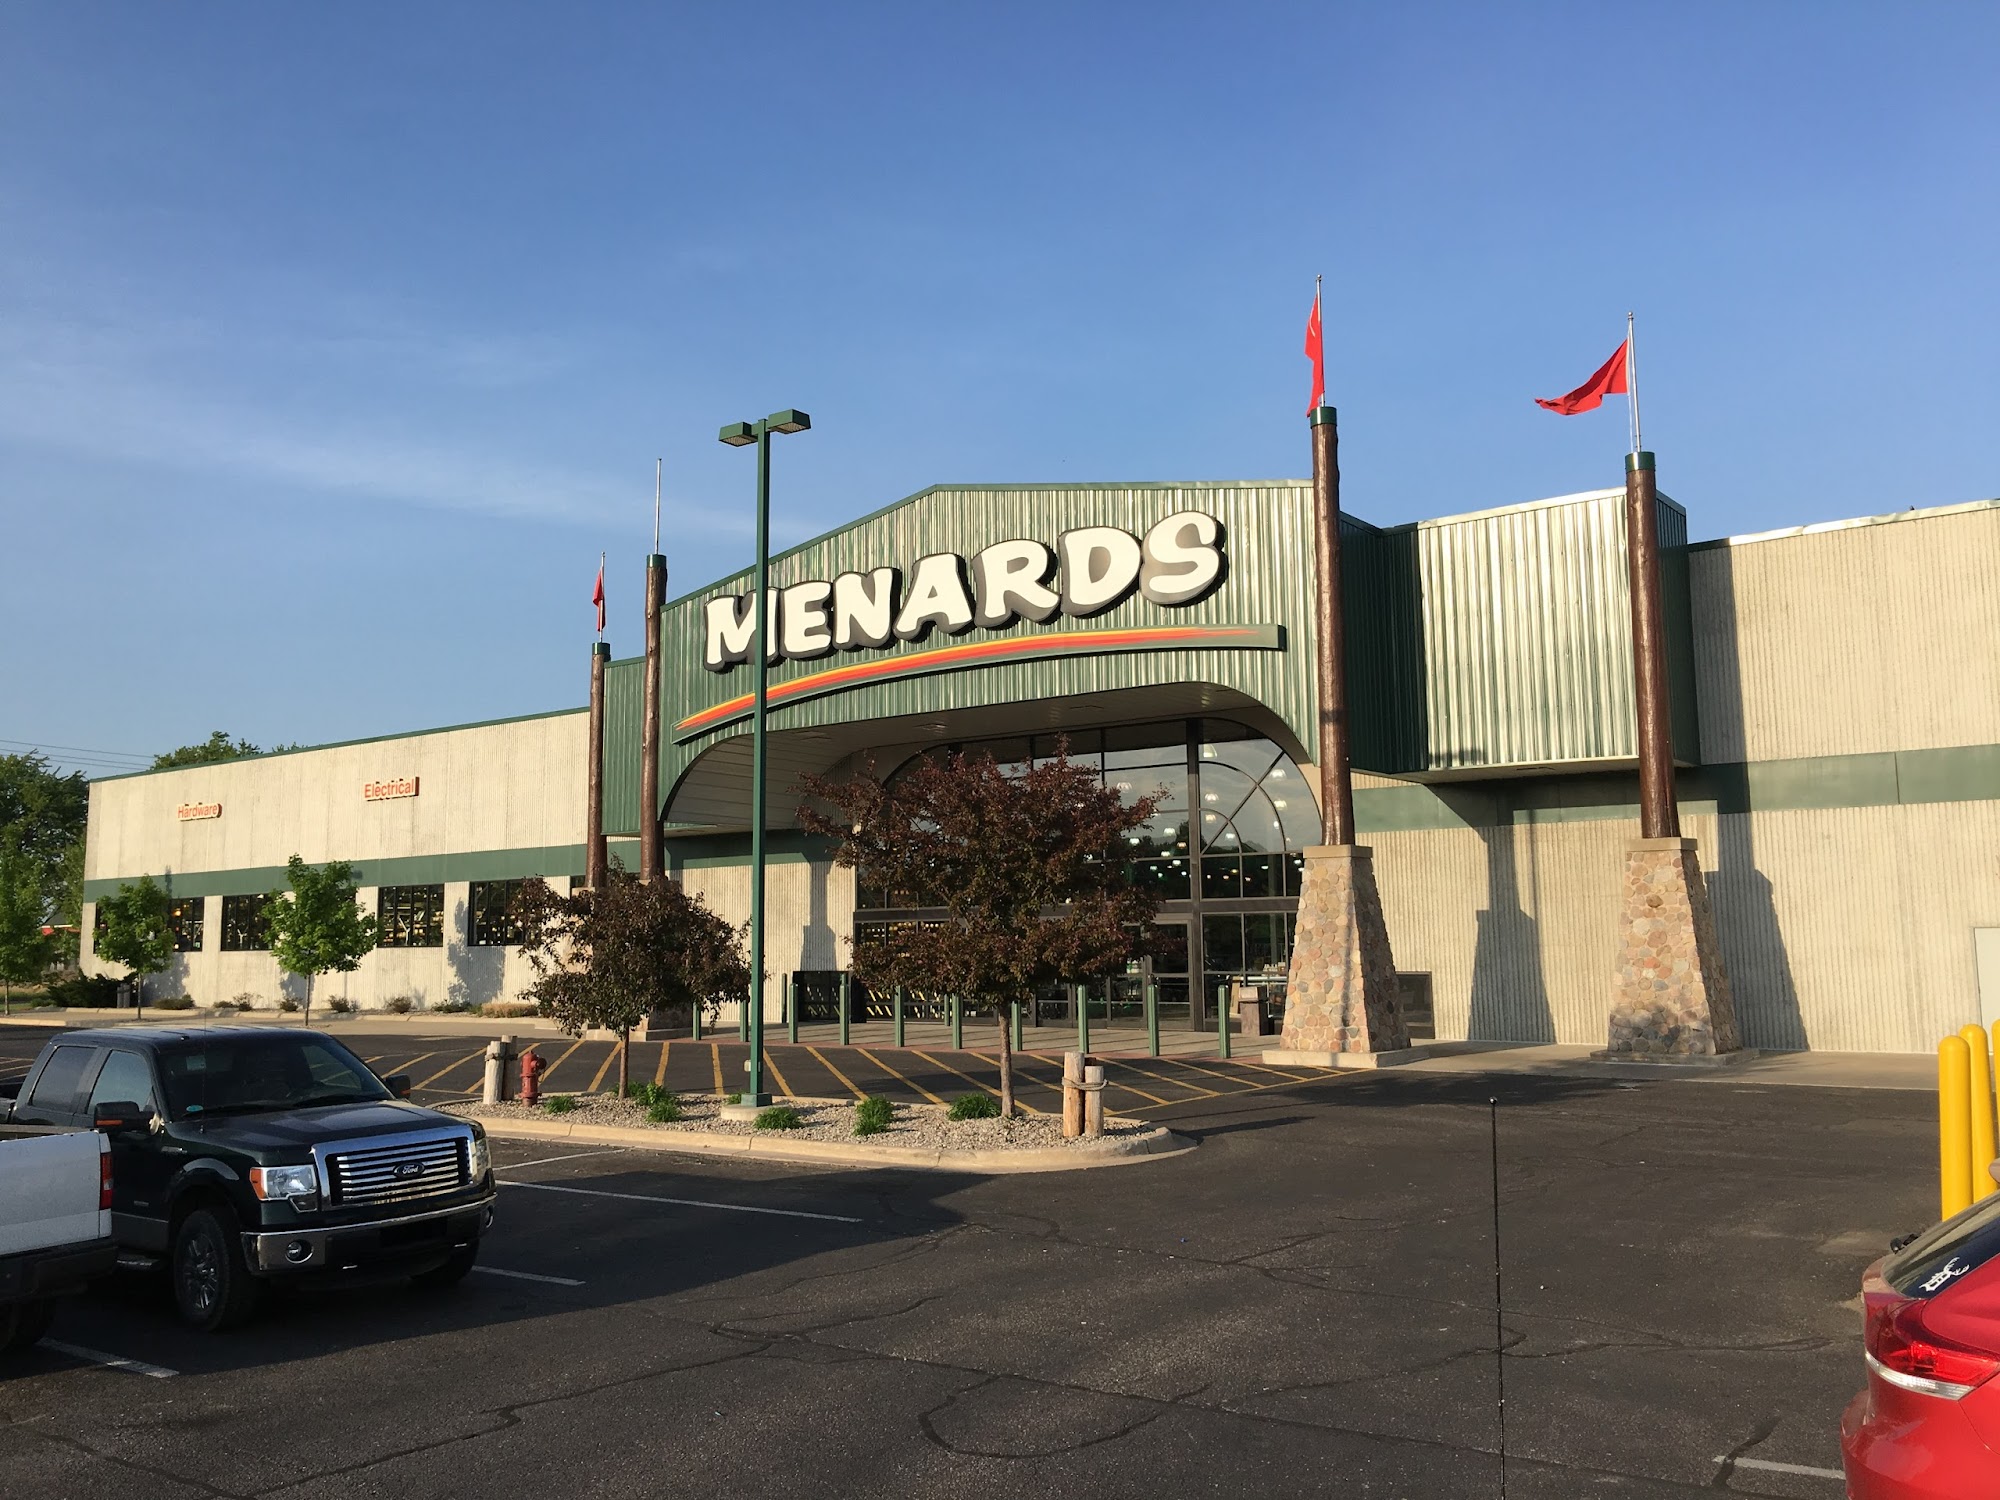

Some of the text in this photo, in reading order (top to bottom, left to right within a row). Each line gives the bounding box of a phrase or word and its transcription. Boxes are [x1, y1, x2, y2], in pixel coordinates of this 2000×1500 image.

[704, 511, 1224, 671] MENARDS
[364, 778, 415, 798] Electrical
[177, 804, 218, 819] Hardware
